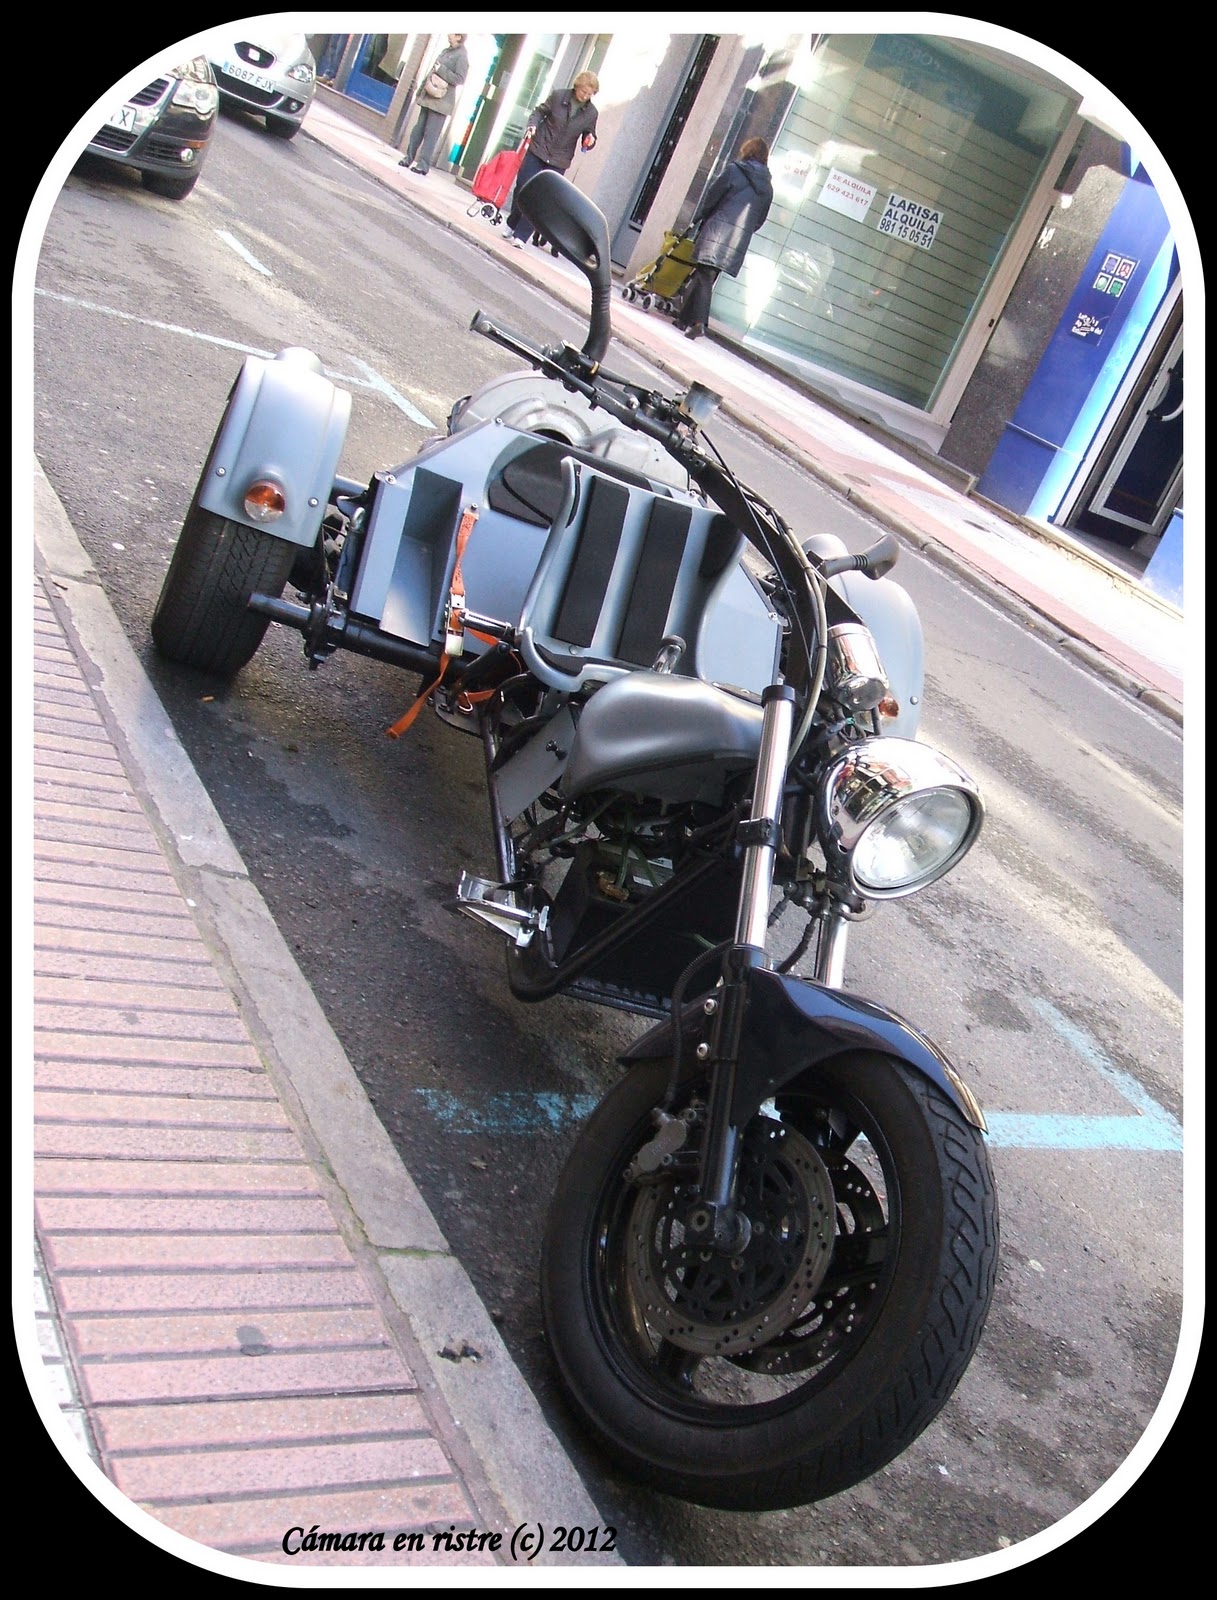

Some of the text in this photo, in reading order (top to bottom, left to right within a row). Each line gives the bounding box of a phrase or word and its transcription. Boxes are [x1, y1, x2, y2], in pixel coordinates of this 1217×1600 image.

[228, 64, 275, 91] 6087 FJX
[826, 183, 869, 206] 629 423 617
[832, 174, 872, 196] SE ALQUILA
[884, 208, 935, 236] ALQUILA
[888, 195, 940, 224] LARISA
[879, 218, 933, 248] 981 15 05 51
